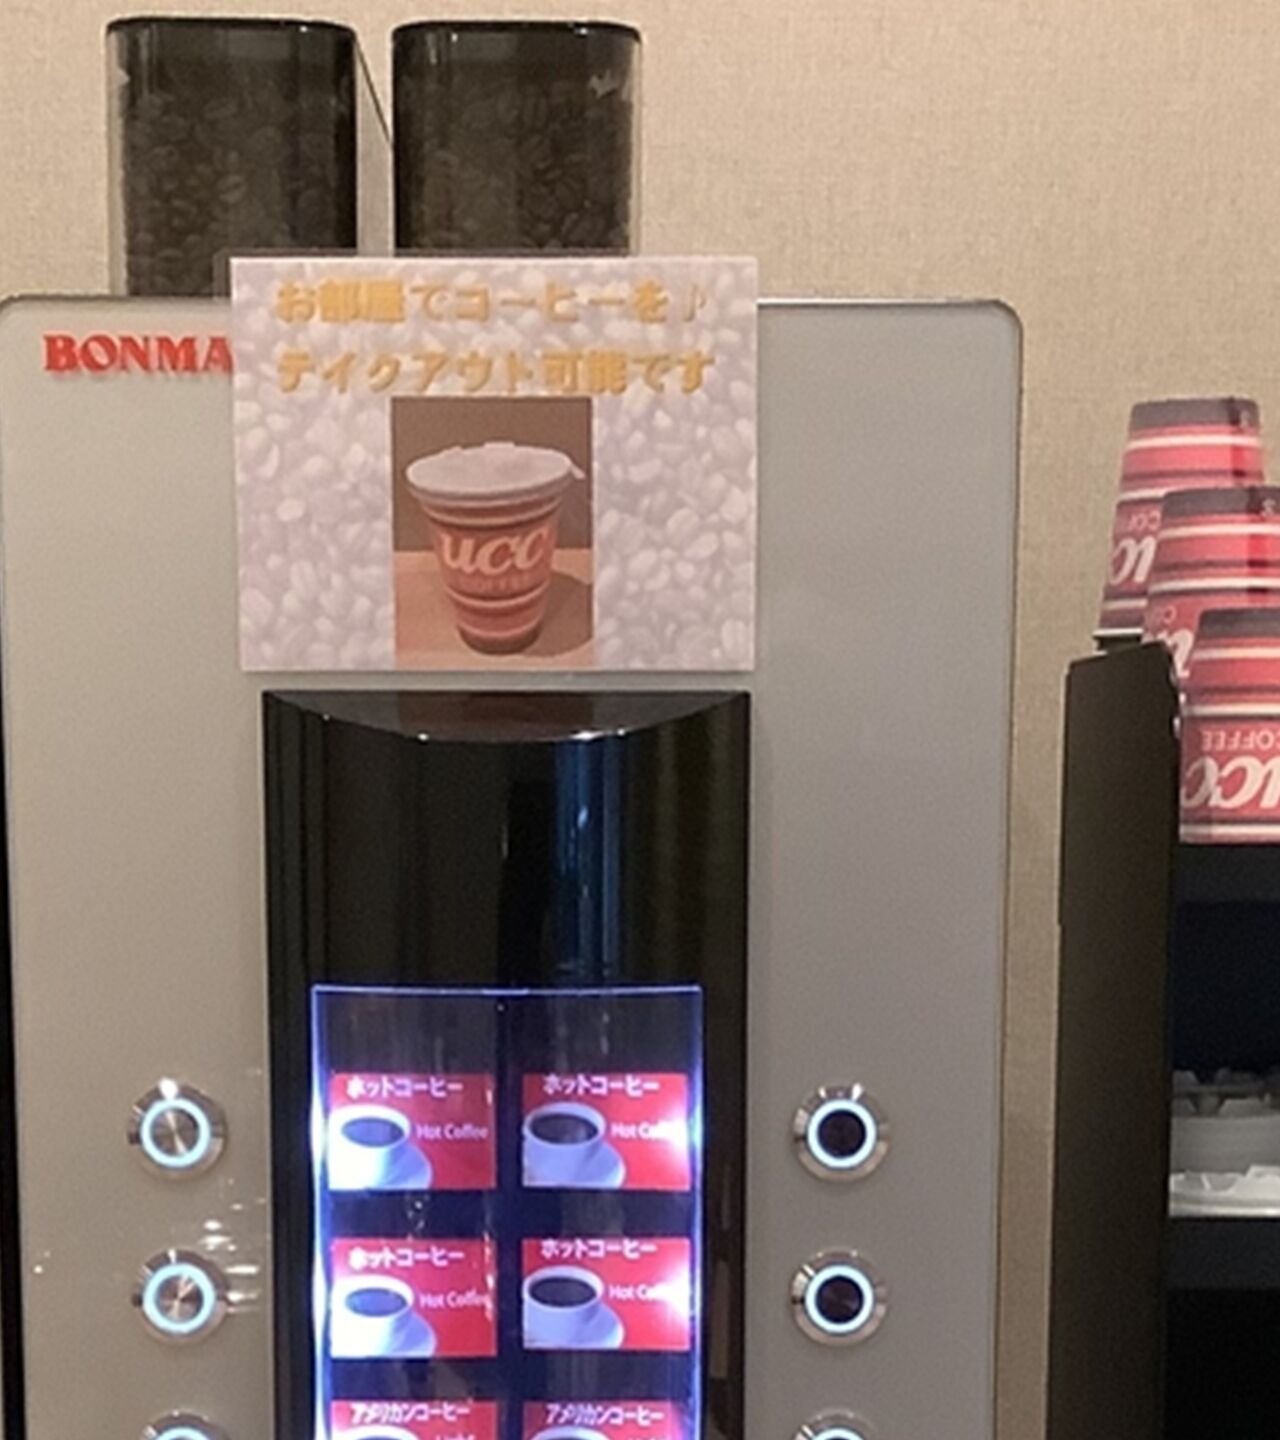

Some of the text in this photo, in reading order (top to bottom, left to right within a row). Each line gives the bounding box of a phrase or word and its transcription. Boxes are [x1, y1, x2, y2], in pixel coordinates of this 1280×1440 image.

[346, 1076, 464, 1098] ホットコーヒー
[543, 1074, 660, 1096] ホットコーヒー
[447, 1123, 490, 1140] Coffee
[349, 1247, 465, 1270] ホットコーヒー
[540, 1239, 658, 1260] ホットコーヒー
